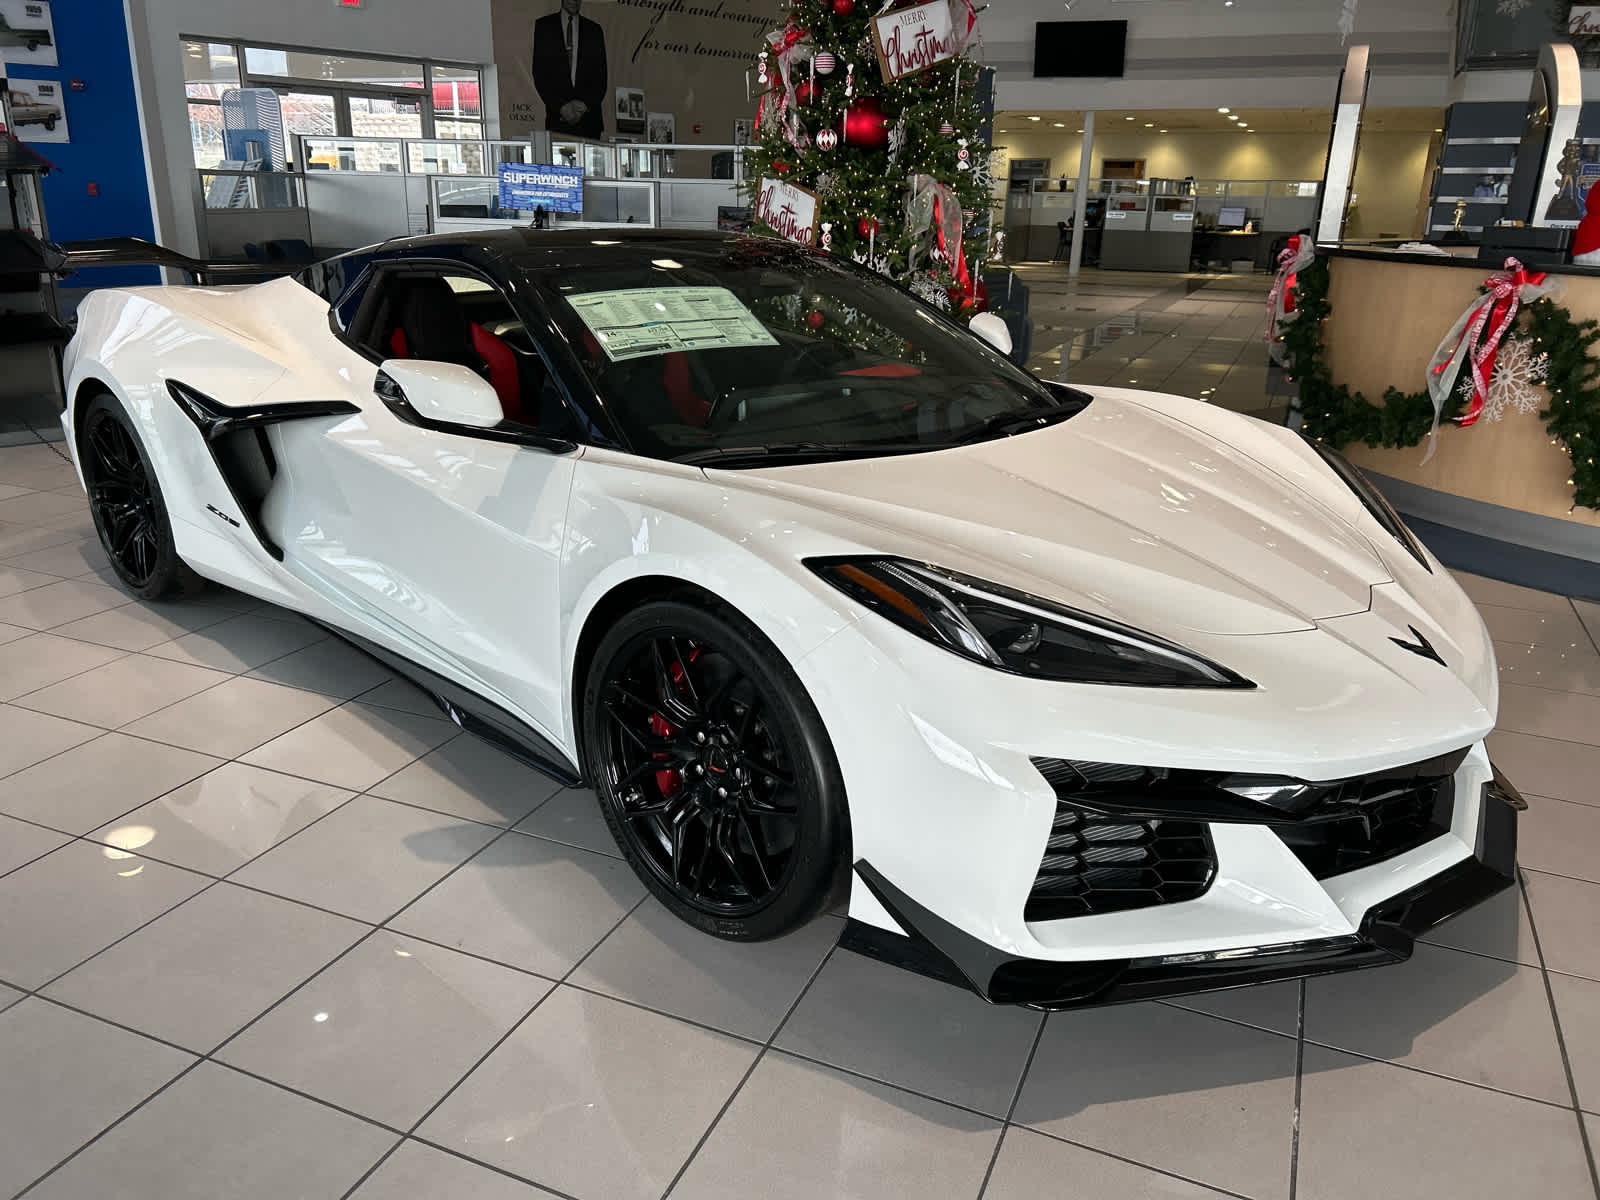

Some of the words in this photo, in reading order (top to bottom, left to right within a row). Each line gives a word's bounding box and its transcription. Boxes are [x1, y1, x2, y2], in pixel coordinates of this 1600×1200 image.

[688, 1, 724, 19] and
[899, 9, 928, 27] MERRY
[632, 27, 660, 64] for
[664, 43, 689, 55] our
[503, 172, 578, 186] SUPERWINCH
